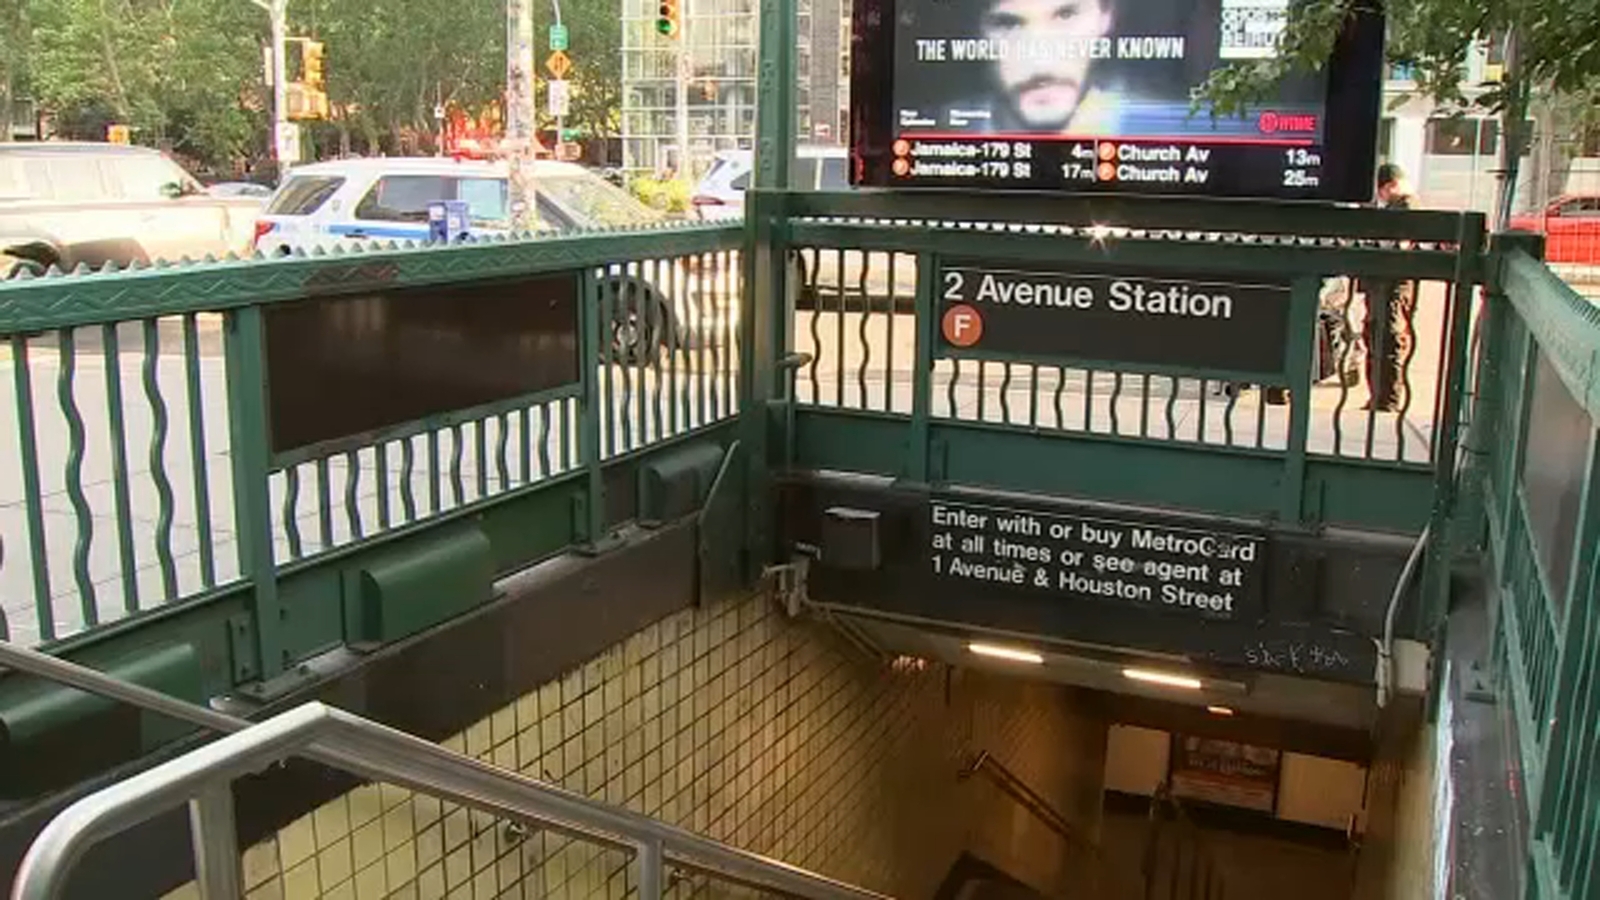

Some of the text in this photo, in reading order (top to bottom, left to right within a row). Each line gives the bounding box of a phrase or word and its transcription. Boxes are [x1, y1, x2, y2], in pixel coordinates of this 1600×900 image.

[916, 39, 946, 61] THE
[951, 39, 1008, 60] WORLD
[1054, 38, 1111, 59] NEVER
[1117, 36, 1185, 59] KNOWN
[910, 141, 1010, 159] Jamaica-179
[1013, 142, 1032, 159] St
[1117, 144, 1181, 162] Church
[1185, 145, 1210, 162] Av
[1285, 149, 1321, 166] 13m
[910, 161, 1010, 178] Jamaica-179
[1013, 161, 1032, 178] St
[1062, 163, 1094, 179] 17m
[1116, 164, 1181, 182] Church
[1184, 166, 1210, 183] Av
[1283, 169, 1319, 187] 25m
[943, 272, 1232, 318] 2 Avenue Station
[953, 314, 972, 338] F
[931, 505, 1256, 562] Enter with or buy MetroCard
[931, 532, 1243, 587] at all times or see agent at
[931, 554, 1234, 612] 1 Avenue & Houston Street
